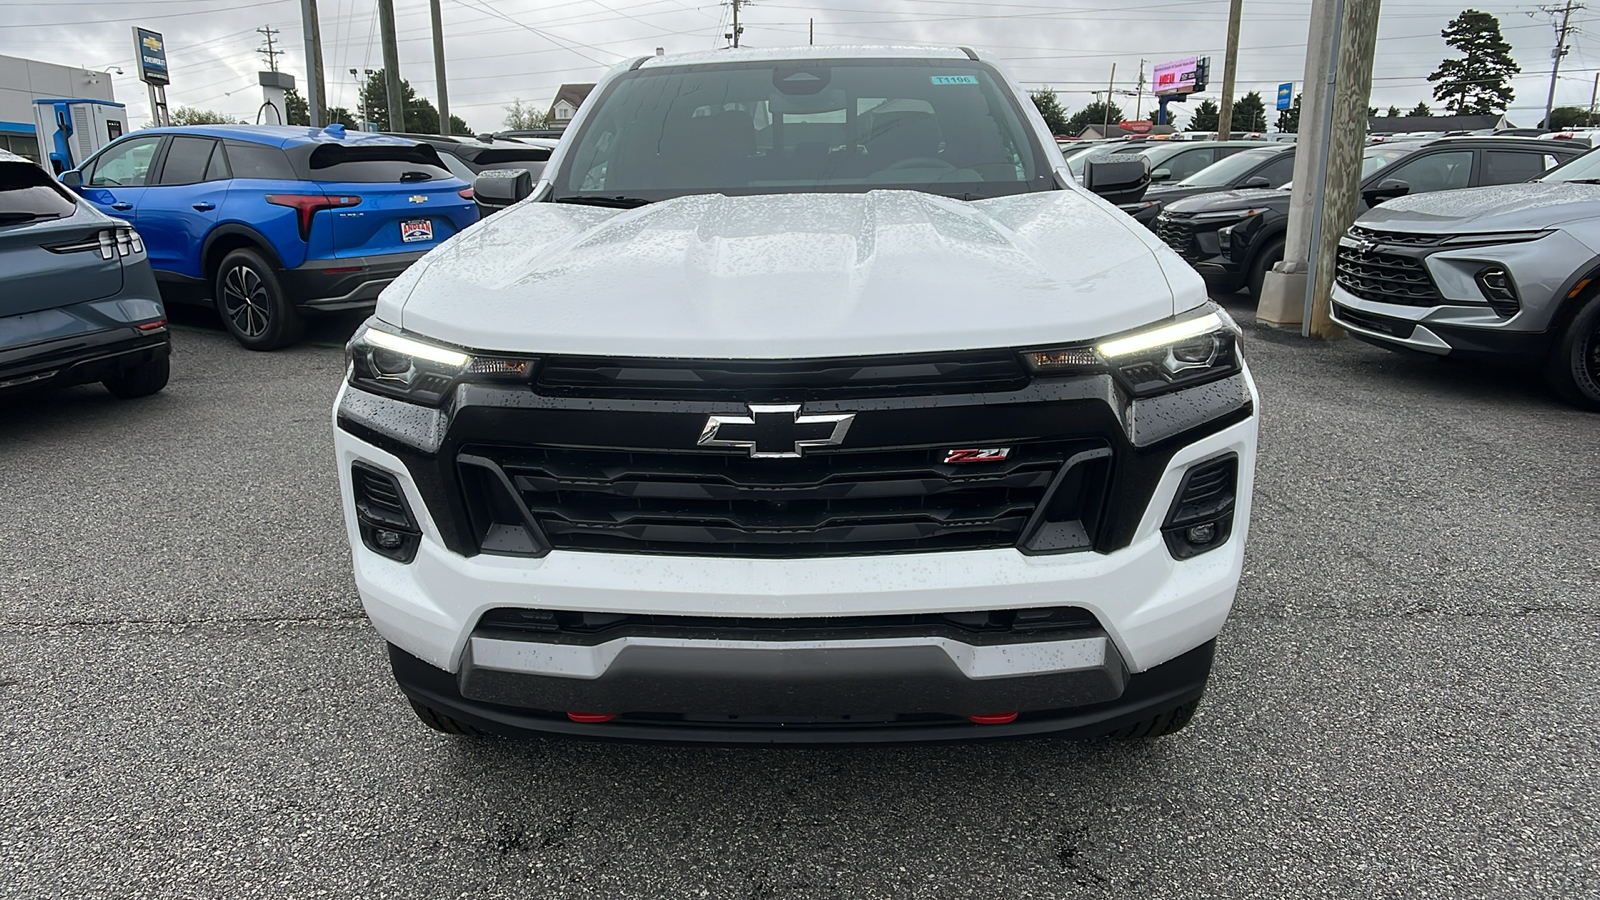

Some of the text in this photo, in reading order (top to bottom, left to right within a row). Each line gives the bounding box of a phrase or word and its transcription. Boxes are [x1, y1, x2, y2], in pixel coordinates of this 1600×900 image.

[936, 76, 971, 84] T1196
[404, 223, 431, 234] ANDEAN
[944, 448, 1010, 463] Z71
